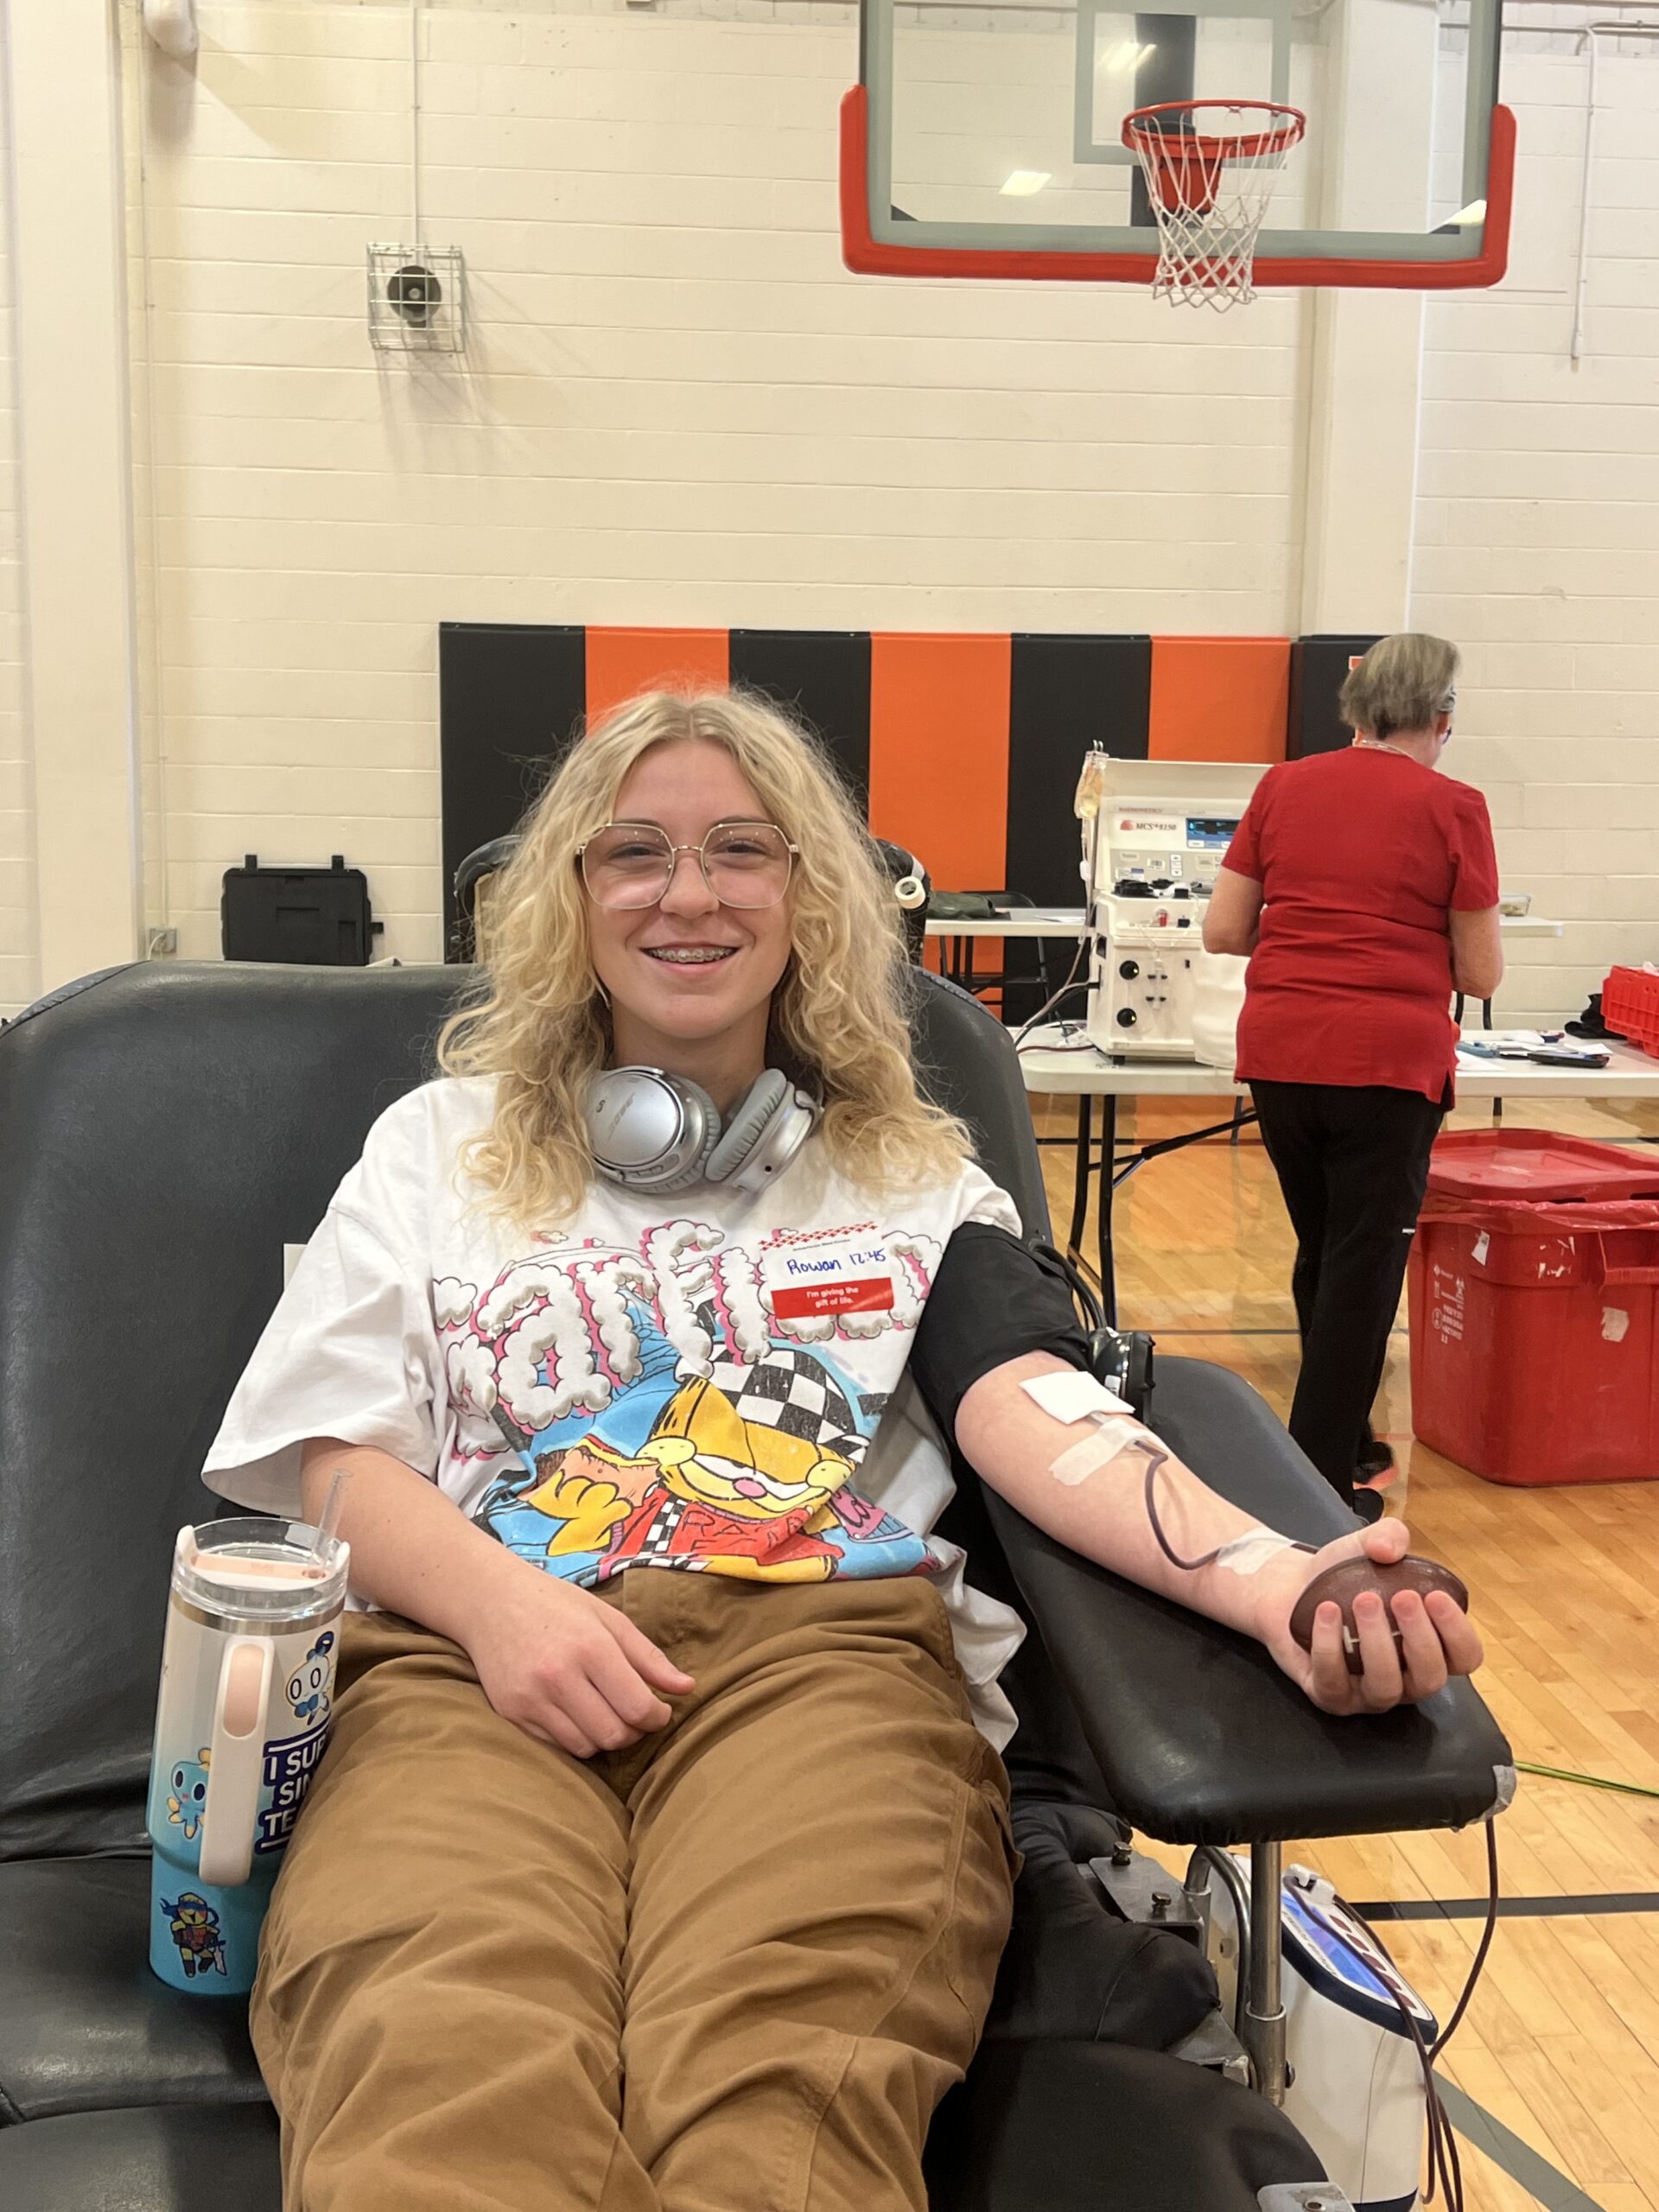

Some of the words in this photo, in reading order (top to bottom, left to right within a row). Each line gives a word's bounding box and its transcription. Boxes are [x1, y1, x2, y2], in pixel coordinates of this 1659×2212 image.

[786, 1258, 842, 1274] Rowan
[849, 1248, 887, 1265] 12:45
[821, 1288, 845, 1298] giving
[815, 1298, 829, 1308] gift
[830, 1297, 838, 1306] of
[270, 1756, 277, 1781] I
